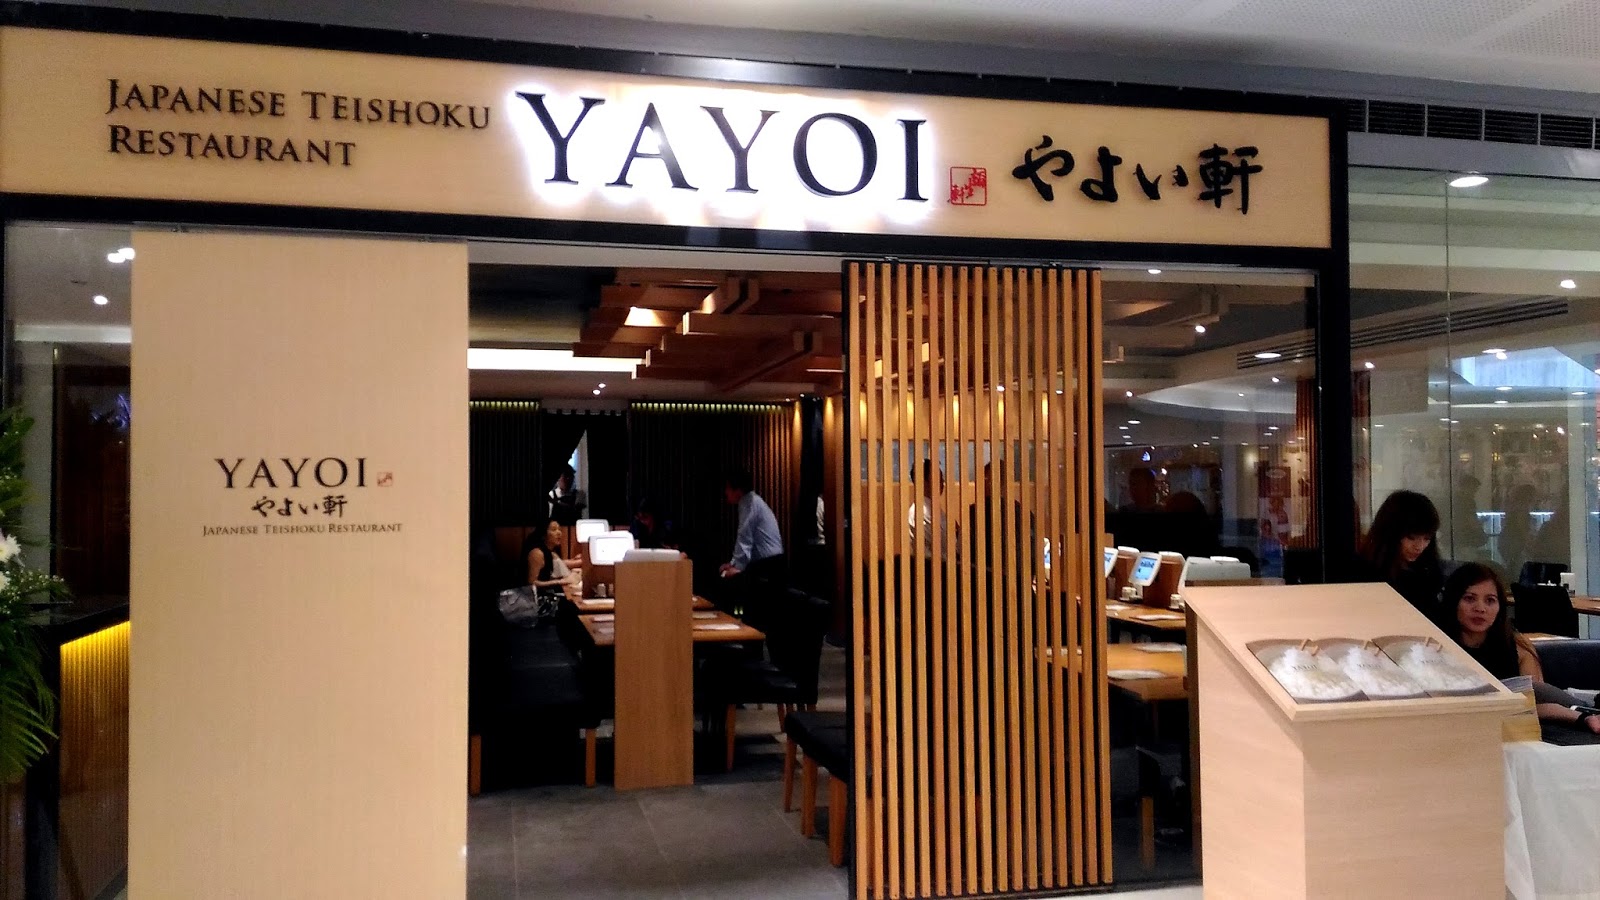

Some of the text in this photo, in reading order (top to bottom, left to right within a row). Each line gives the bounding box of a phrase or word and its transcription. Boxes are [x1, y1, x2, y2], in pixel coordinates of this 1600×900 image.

[105, 78, 491, 129] JAPANESE TEISHOKU
[108, 124, 356, 167] RESTAURANT
[515, 91, 929, 202] YAYOI
[1012, 135, 1263, 214] やよい軒
[214, 457, 367, 489] YAYOI
[251, 496, 348, 518] やよい軒
[202, 523, 403, 537] JAPANESE TEISHOKU RESTAURANT
